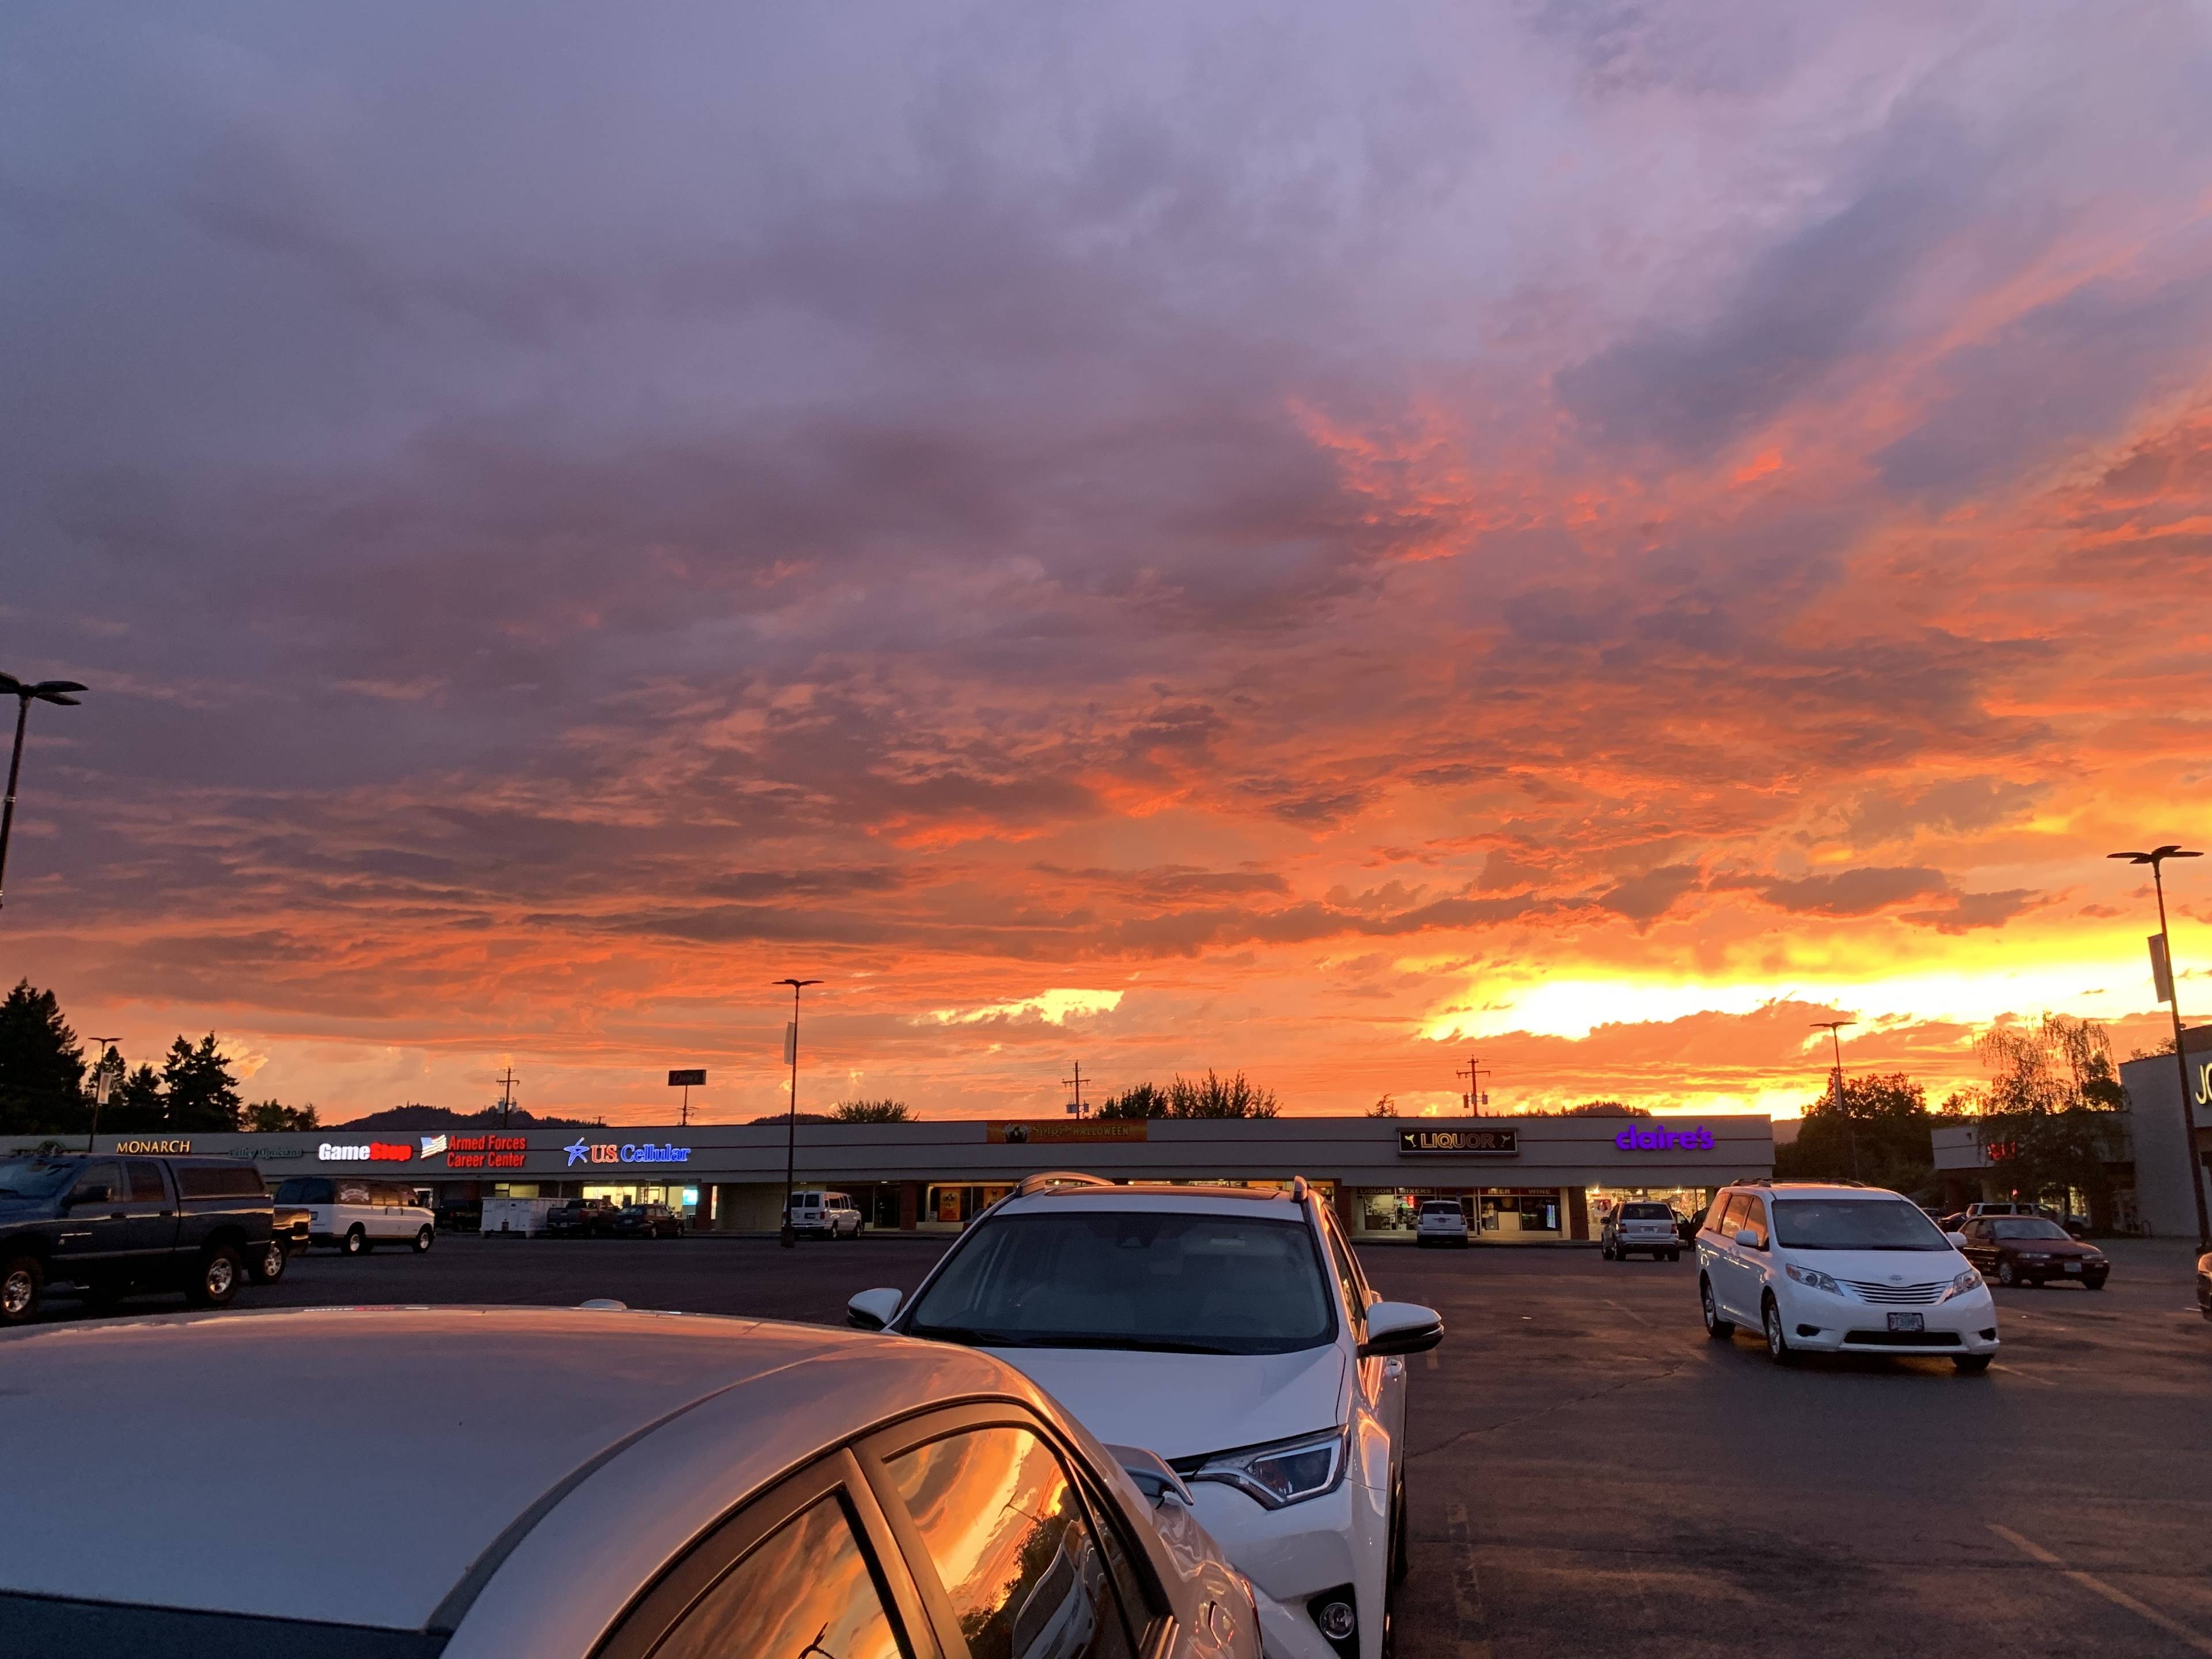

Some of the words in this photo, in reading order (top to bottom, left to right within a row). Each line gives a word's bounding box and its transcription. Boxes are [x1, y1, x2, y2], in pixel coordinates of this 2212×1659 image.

[1073, 1126, 1130, 1136] HALLOWEEN
[1615, 1124, 1715, 1150] claire's
[116, 1140, 191, 1153] MONARCH
[449, 1135, 485, 1151] Armed
[488, 1134, 526, 1150] Forces
[1421, 1132, 1496, 1149] LIQUOR
[319, 1142, 413, 1161] GameStop
[447, 1152, 484, 1168] Career
[487, 1152, 525, 1167] Center
[620, 1143, 691, 1162] Cellular
